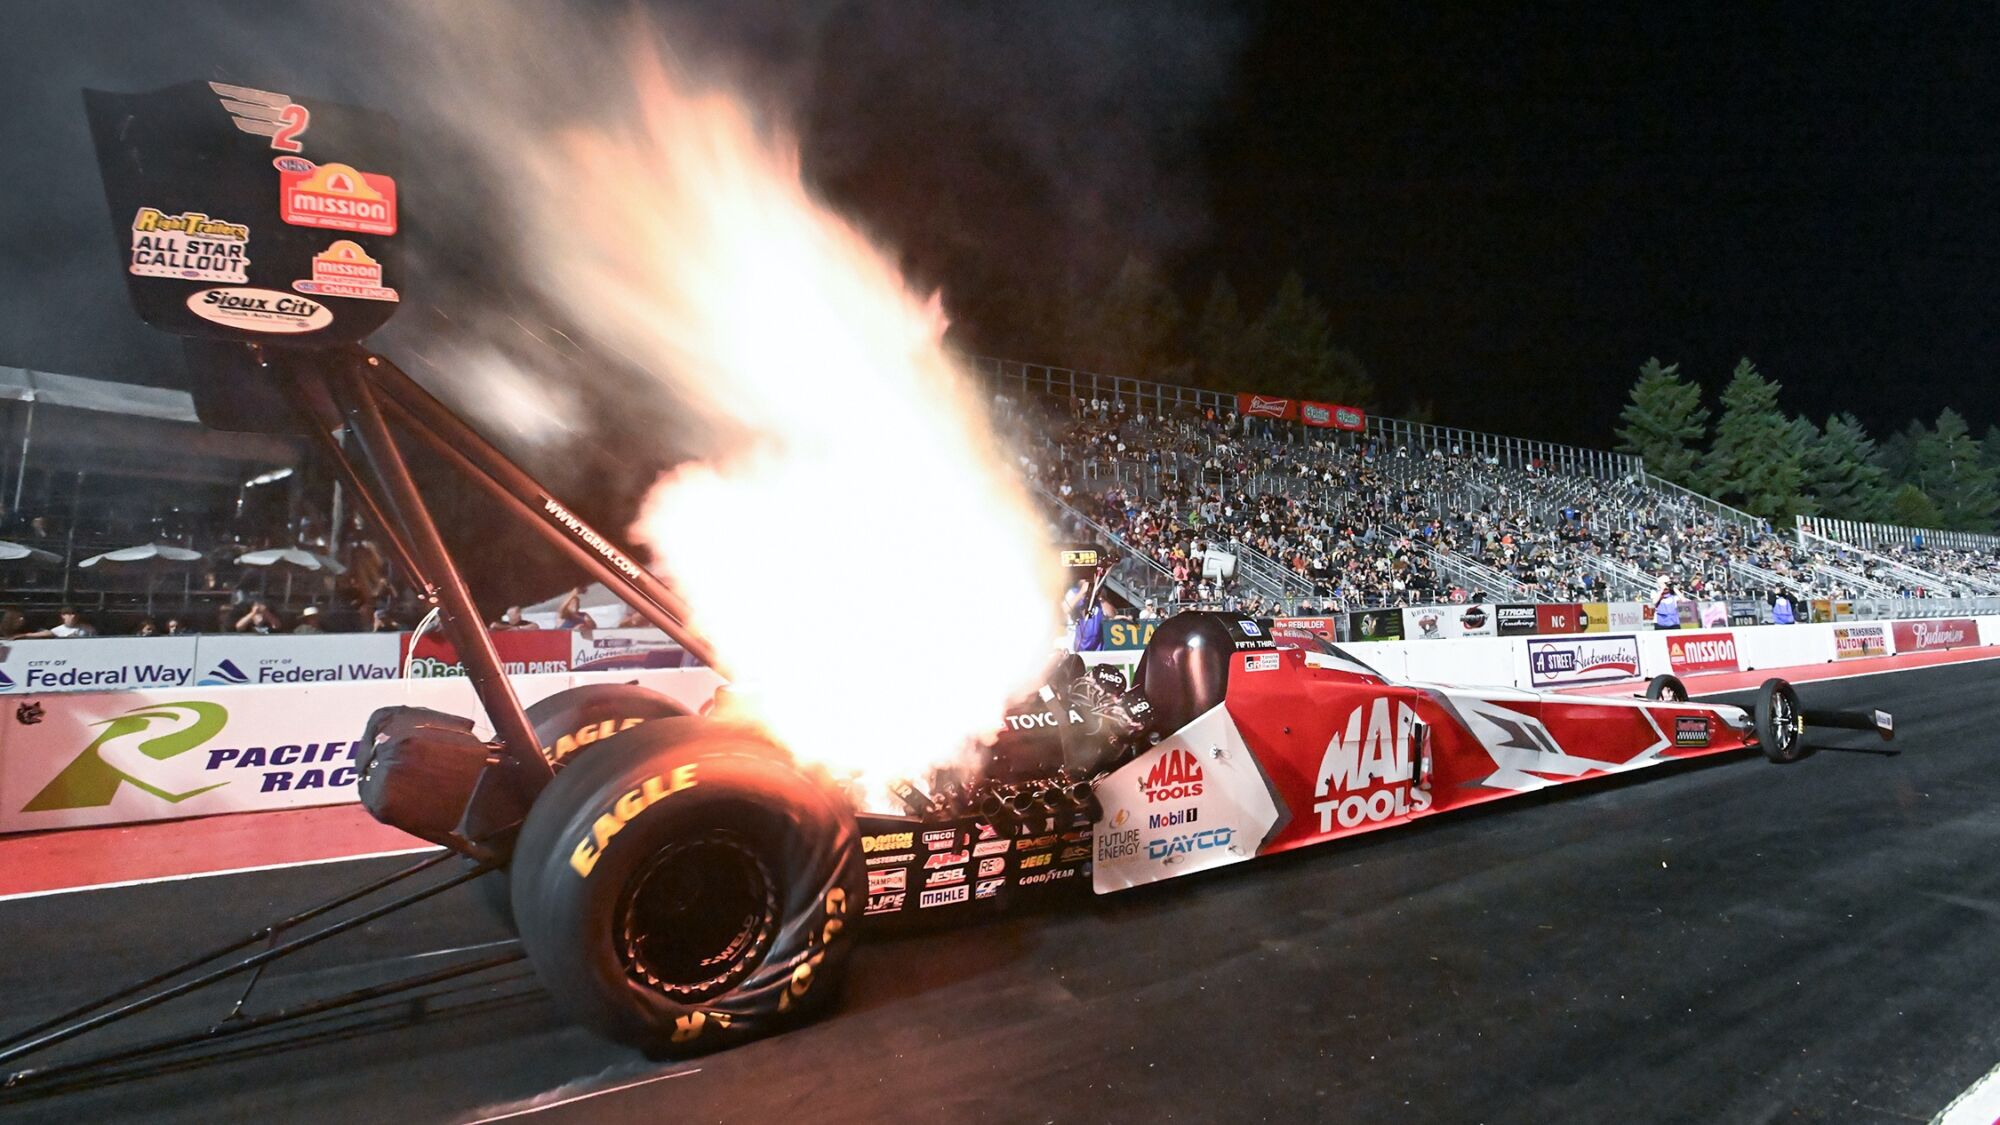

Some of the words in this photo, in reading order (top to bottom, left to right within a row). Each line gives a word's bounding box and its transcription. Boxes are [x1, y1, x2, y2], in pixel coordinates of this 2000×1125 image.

[271, 104, 310, 153] 2
[137, 236, 179, 252] ALL
[187, 240, 241, 258] STAR
[136, 250, 241, 272] CALLOUT
[203, 290, 268, 310] Sioux
[276, 298, 320, 317] City
[1288, 620, 1325, 629] REBUILDER
[1552, 615, 1565, 628] NC
[1849, 627, 1883, 636] TRANSMISSION
[1912, 623, 1964, 648] Budweiser
[1235, 641, 1256, 649] FIFTH
[1837, 637, 1884, 649] AUTOMOTIVE
[1536, 653, 1546, 671] A
[1548, 653, 1574, 669] STREET
[1574, 645, 1637, 668] Automotive
[26, 666, 128, 687] Federal
[134, 665, 192, 686] Way
[259, 665, 343, 683] Federal
[529, 661, 568, 674] PARTS
[1099, 672, 1123, 684] MSD
[1129, 701, 1150, 715] MSD
[1006, 709, 1084, 730] TOYOA
[206, 741, 361, 770] PACIFI
[1146, 749, 1203, 789] MAC
[260, 766, 357, 792] RAC
[1146, 783, 1203, 803] TOOLS
[1314, 787, 1432, 833] TOOLS
[569, 763, 699, 878] EAGLE
[1149, 811, 1184, 829] Mobil
[1099, 829, 1140, 847] FUTURE
[1144, 827, 1236, 860] DAYCO
[1098, 843, 1140, 861] ENERGY
[869, 876, 903, 887] HAMPION
[926, 868, 966, 884] JESEL
[1019, 868, 1075, 886] GOODYEAR
[922, 889, 964, 905] MAHLE
